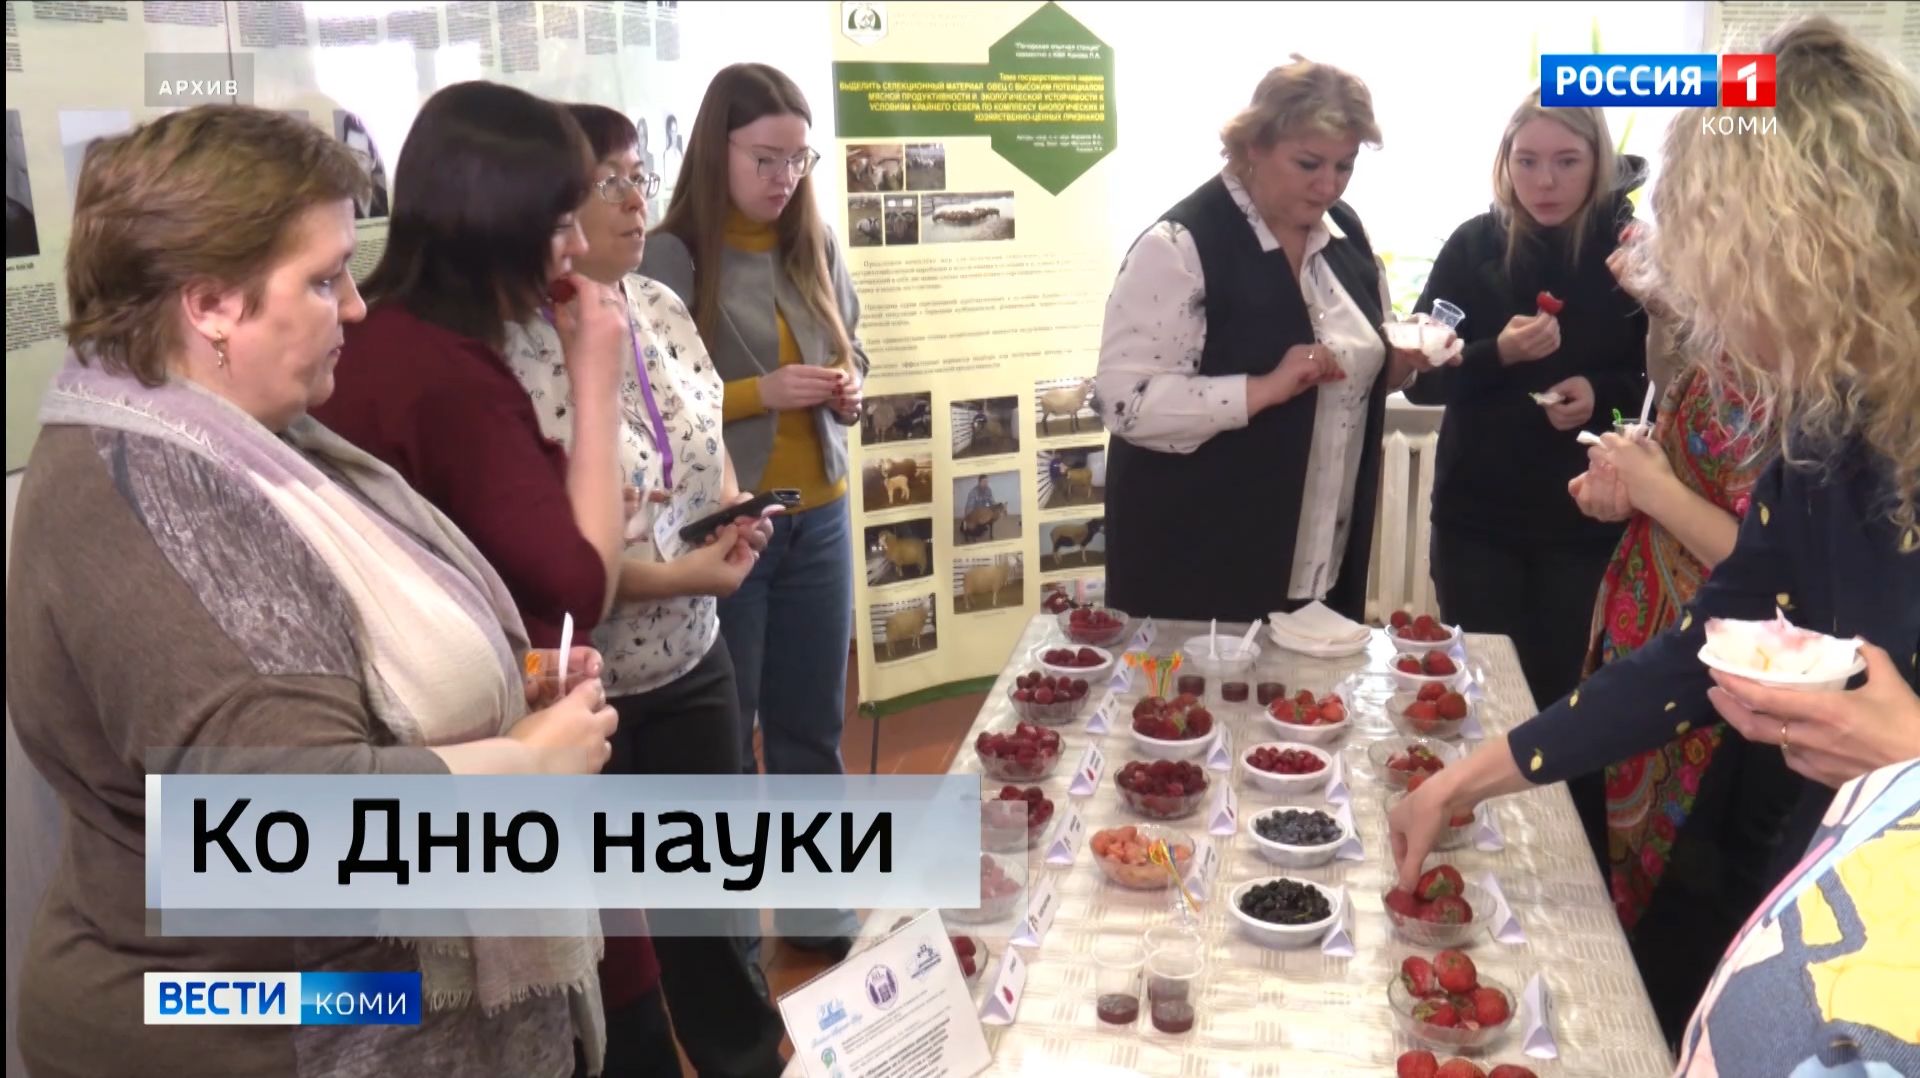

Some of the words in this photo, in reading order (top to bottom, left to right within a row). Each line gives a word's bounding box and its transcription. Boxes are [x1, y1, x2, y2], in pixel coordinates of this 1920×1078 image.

[839, 82, 881, 92] ВЫДЕЛИТЬ
[882, 82, 945, 92] СЕЛЕКЦИОННЫЙ
[946, 82, 983, 91] МАТЕРИАЛ
[987, 82, 1008, 91] ОВЕЦ
[1015, 82, 1052, 91] ВЫСОКИМ
[1053, 82, 1104, 91] ПОТЕНЦИАЛОМ
[868, 92, 901, 101] МЯСНОЙ
[902, 92, 969, 101] ПРОДУКТИВНОСТИ
[981, 92, 1042, 101] ЭКОЛОГИЧЕСКОЙ
[869, 102, 911, 112] УСЛОВИЯМ
[911, 102, 951, 112] КРАЙНЕГО
[952, 102, 980, 112] СЕВЕРА
[994, 102, 1037, 111] КОМПЛЕКСУ
[1038, 102, 1098, 111] БИОЛОГИЧЕСКИХ
